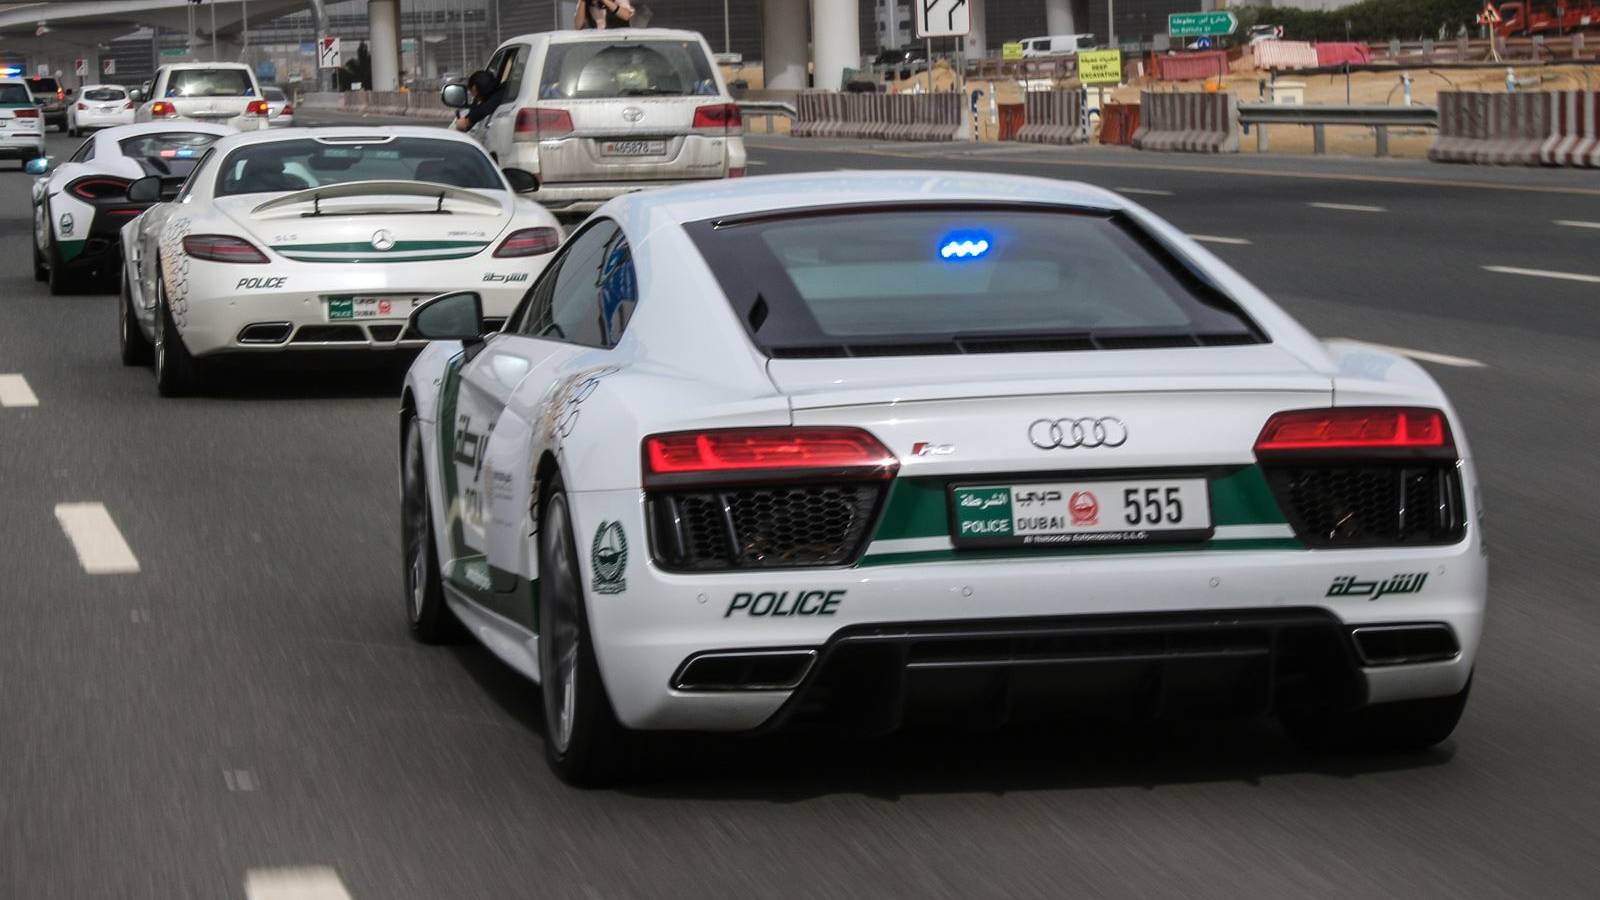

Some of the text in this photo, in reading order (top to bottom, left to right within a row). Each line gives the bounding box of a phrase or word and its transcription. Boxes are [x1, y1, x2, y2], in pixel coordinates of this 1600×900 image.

[236, 276, 287, 289] POLICE
[482, 272, 528, 283] الشرطة
[959, 492, 1008, 510] الشرطة
[1123, 487, 1184, 526] 555
[962, 519, 1010, 533] POLICE
[1017, 516, 1065, 531] DUBAI
[1325, 571, 1429, 601] الشرطة
[724, 589, 847, 618] POLICE
